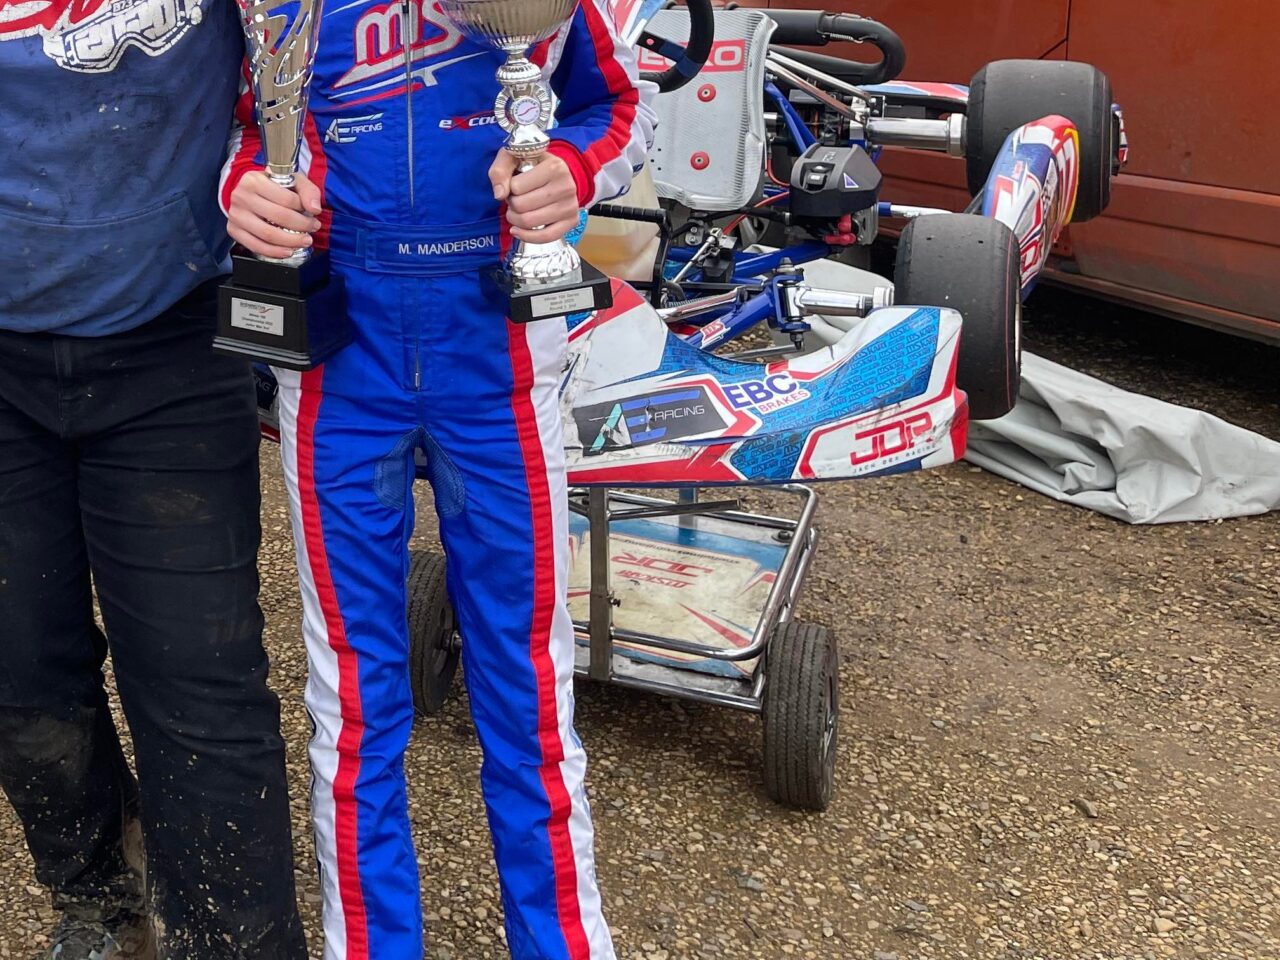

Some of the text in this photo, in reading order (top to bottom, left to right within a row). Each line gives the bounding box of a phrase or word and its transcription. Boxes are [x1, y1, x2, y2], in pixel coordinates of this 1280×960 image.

[398, 235, 494, 255] M. MANDERSON
[722, 373, 798, 410] EBC
[760, 389, 809, 413] BRAKES
[654, 404, 705, 422] RACING
